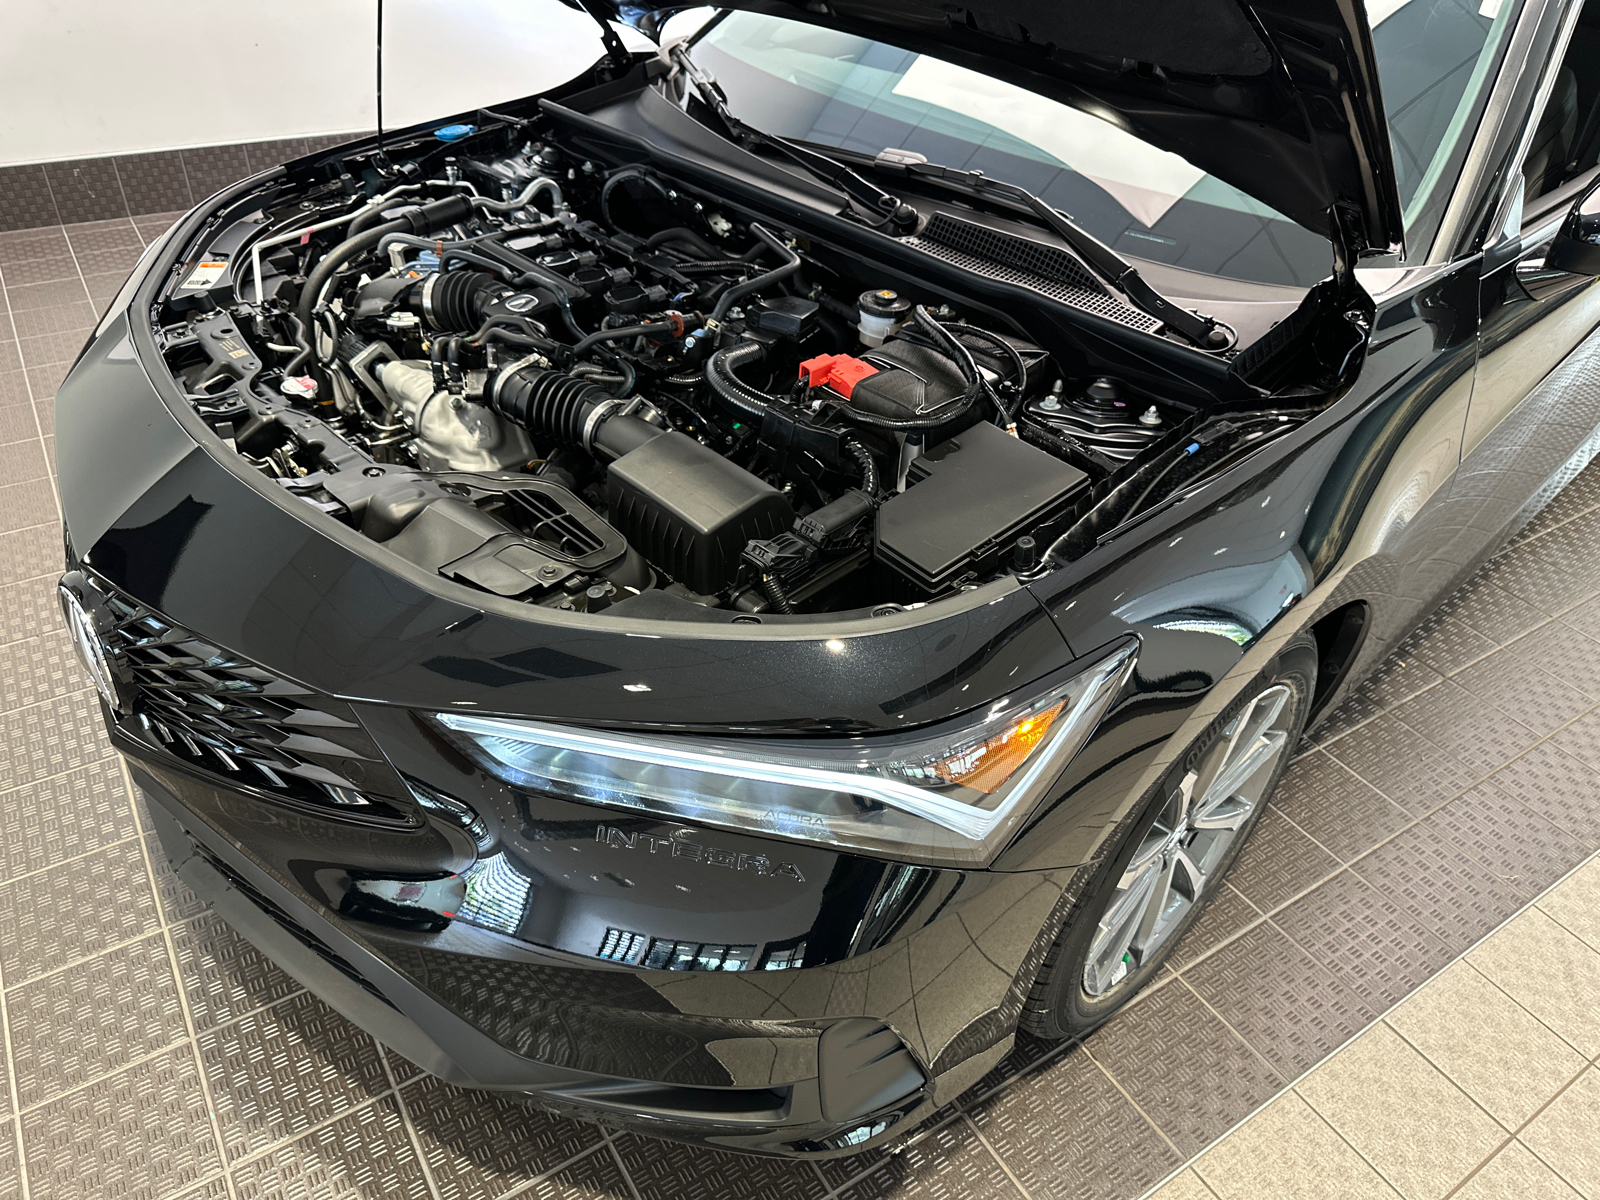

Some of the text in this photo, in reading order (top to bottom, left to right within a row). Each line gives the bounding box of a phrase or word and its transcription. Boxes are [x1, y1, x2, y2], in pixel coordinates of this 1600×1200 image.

[1183, 677, 1259, 773] Continental
[763, 808, 825, 827] ACURA
[595, 824, 806, 882] INTEGRA
